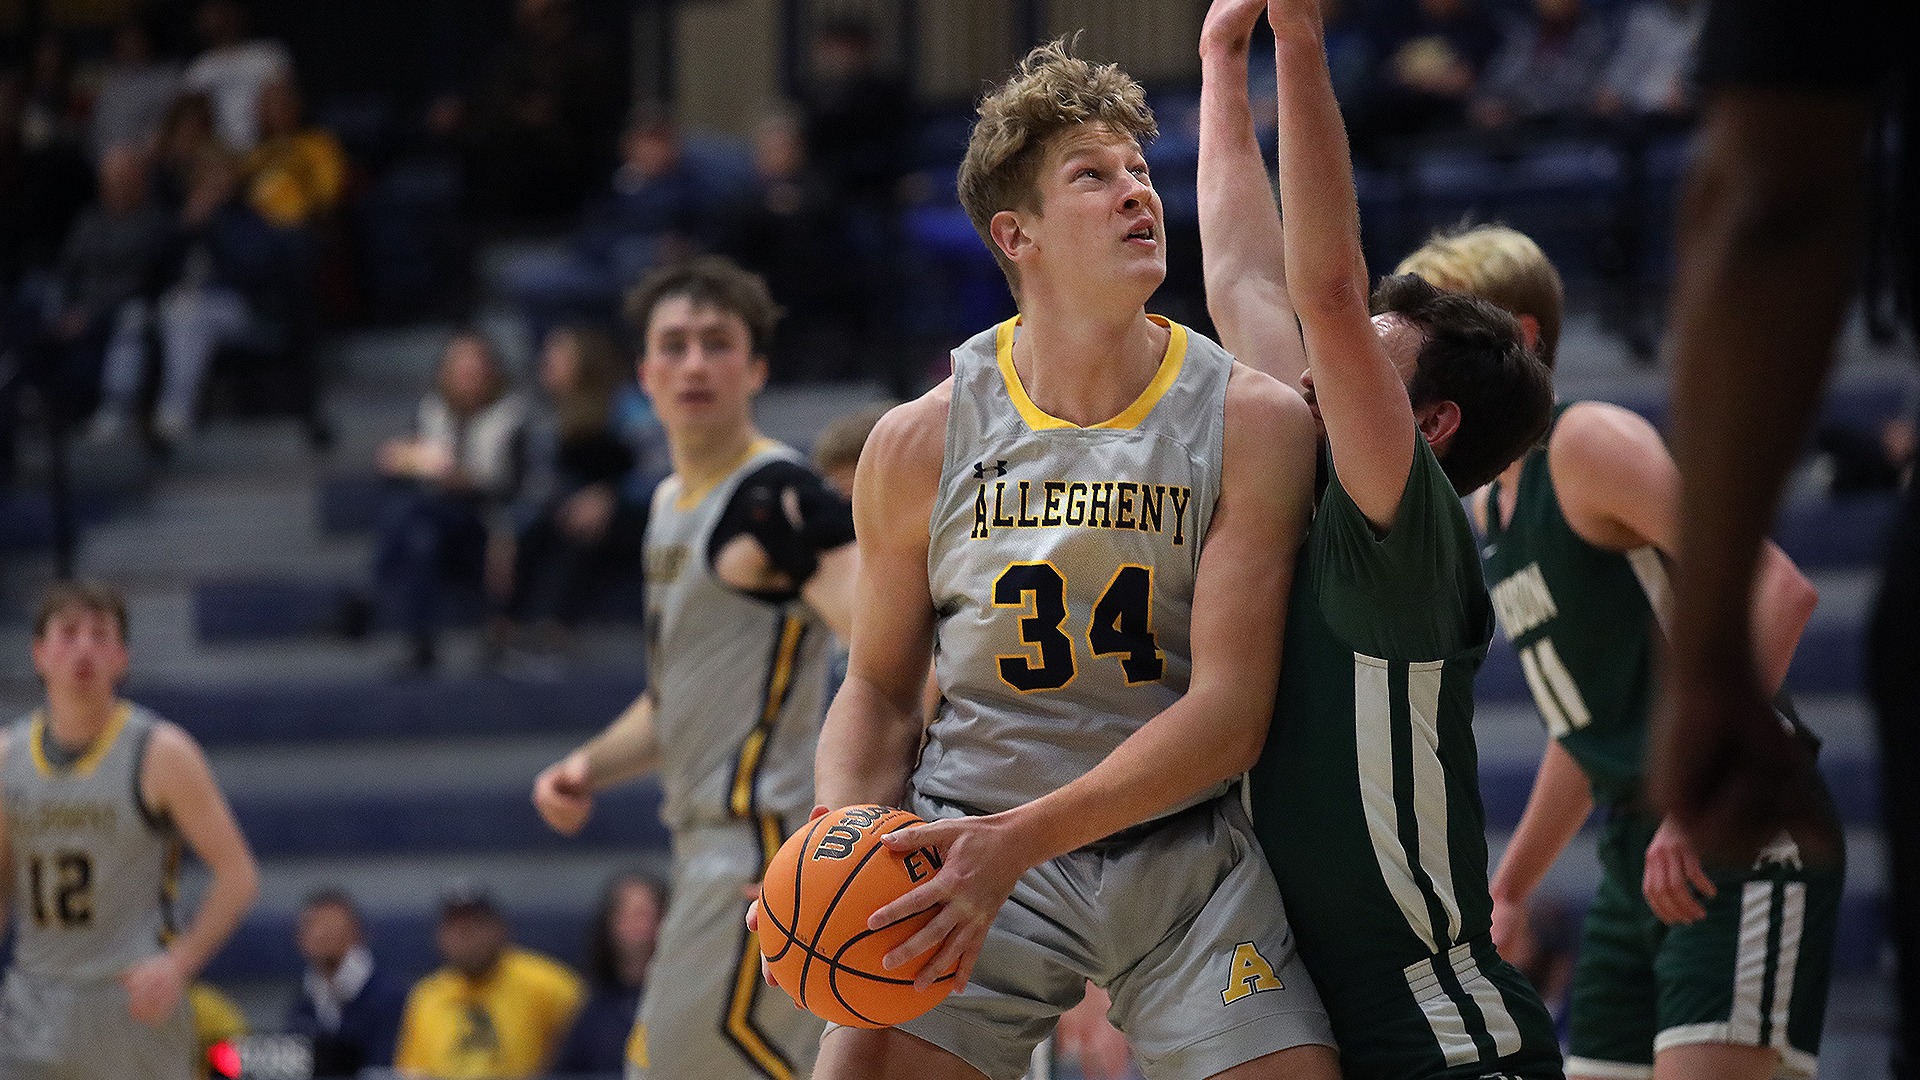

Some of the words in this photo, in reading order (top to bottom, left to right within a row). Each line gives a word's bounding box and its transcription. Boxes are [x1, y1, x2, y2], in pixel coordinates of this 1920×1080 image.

[970, 480, 1191, 545] ALLEGHENY
[991, 560, 1167, 694] 34
[28, 850, 95, 929] 12
[903, 845, 943, 884] EV
[1220, 940, 1286, 1007] A
